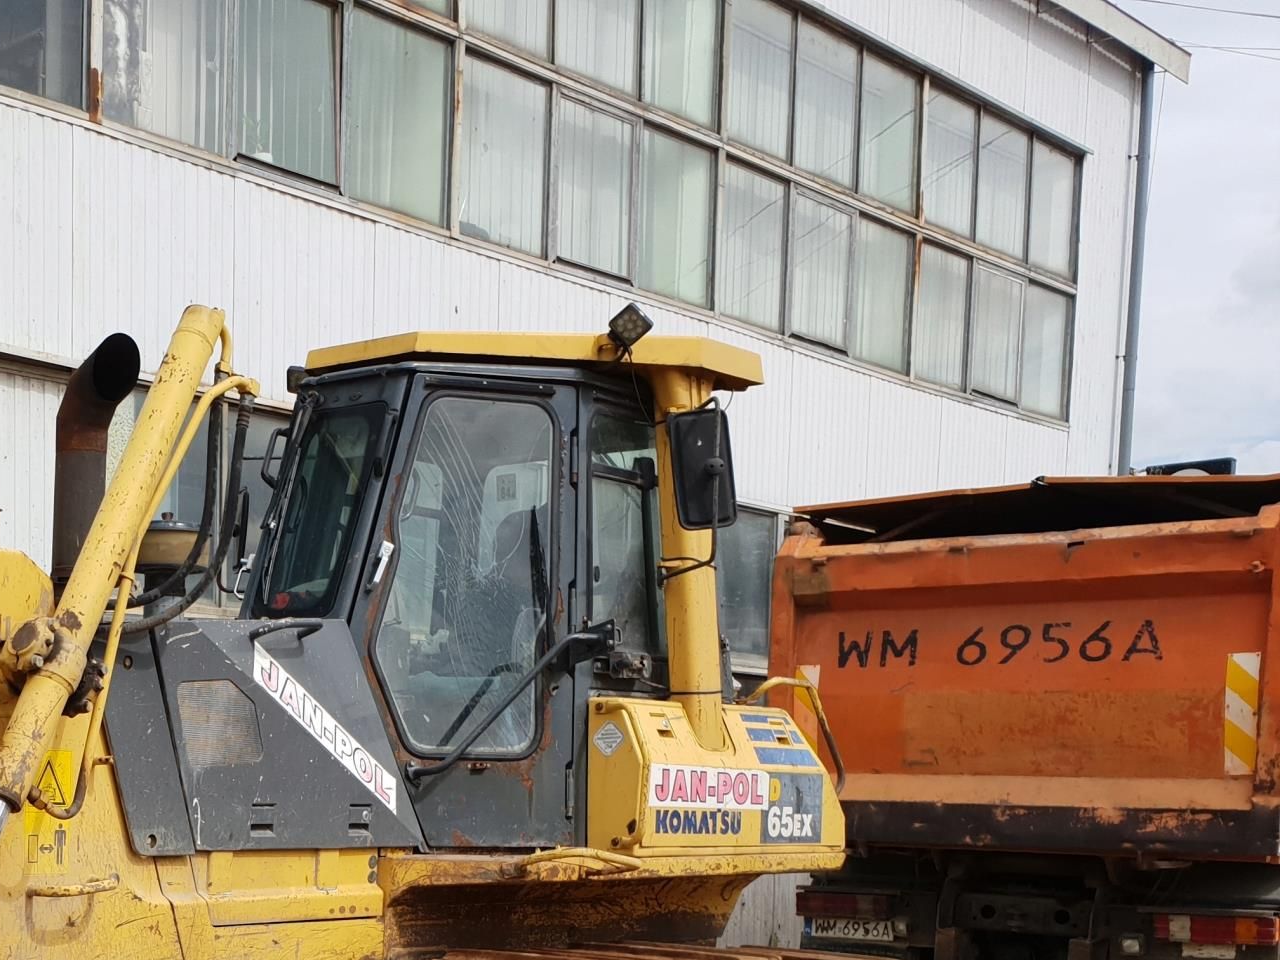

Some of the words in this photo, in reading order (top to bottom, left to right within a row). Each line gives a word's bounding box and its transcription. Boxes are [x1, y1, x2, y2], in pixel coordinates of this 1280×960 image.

[837, 629, 919, 668] WM
[956, 618, 1165, 665] 6956A
[261, 660, 391, 805] JAN-POL
[654, 768, 764, 805] JAN-POL
[654, 808, 742, 835] KOMATSU
[842, 920, 890, 939] 6956A
